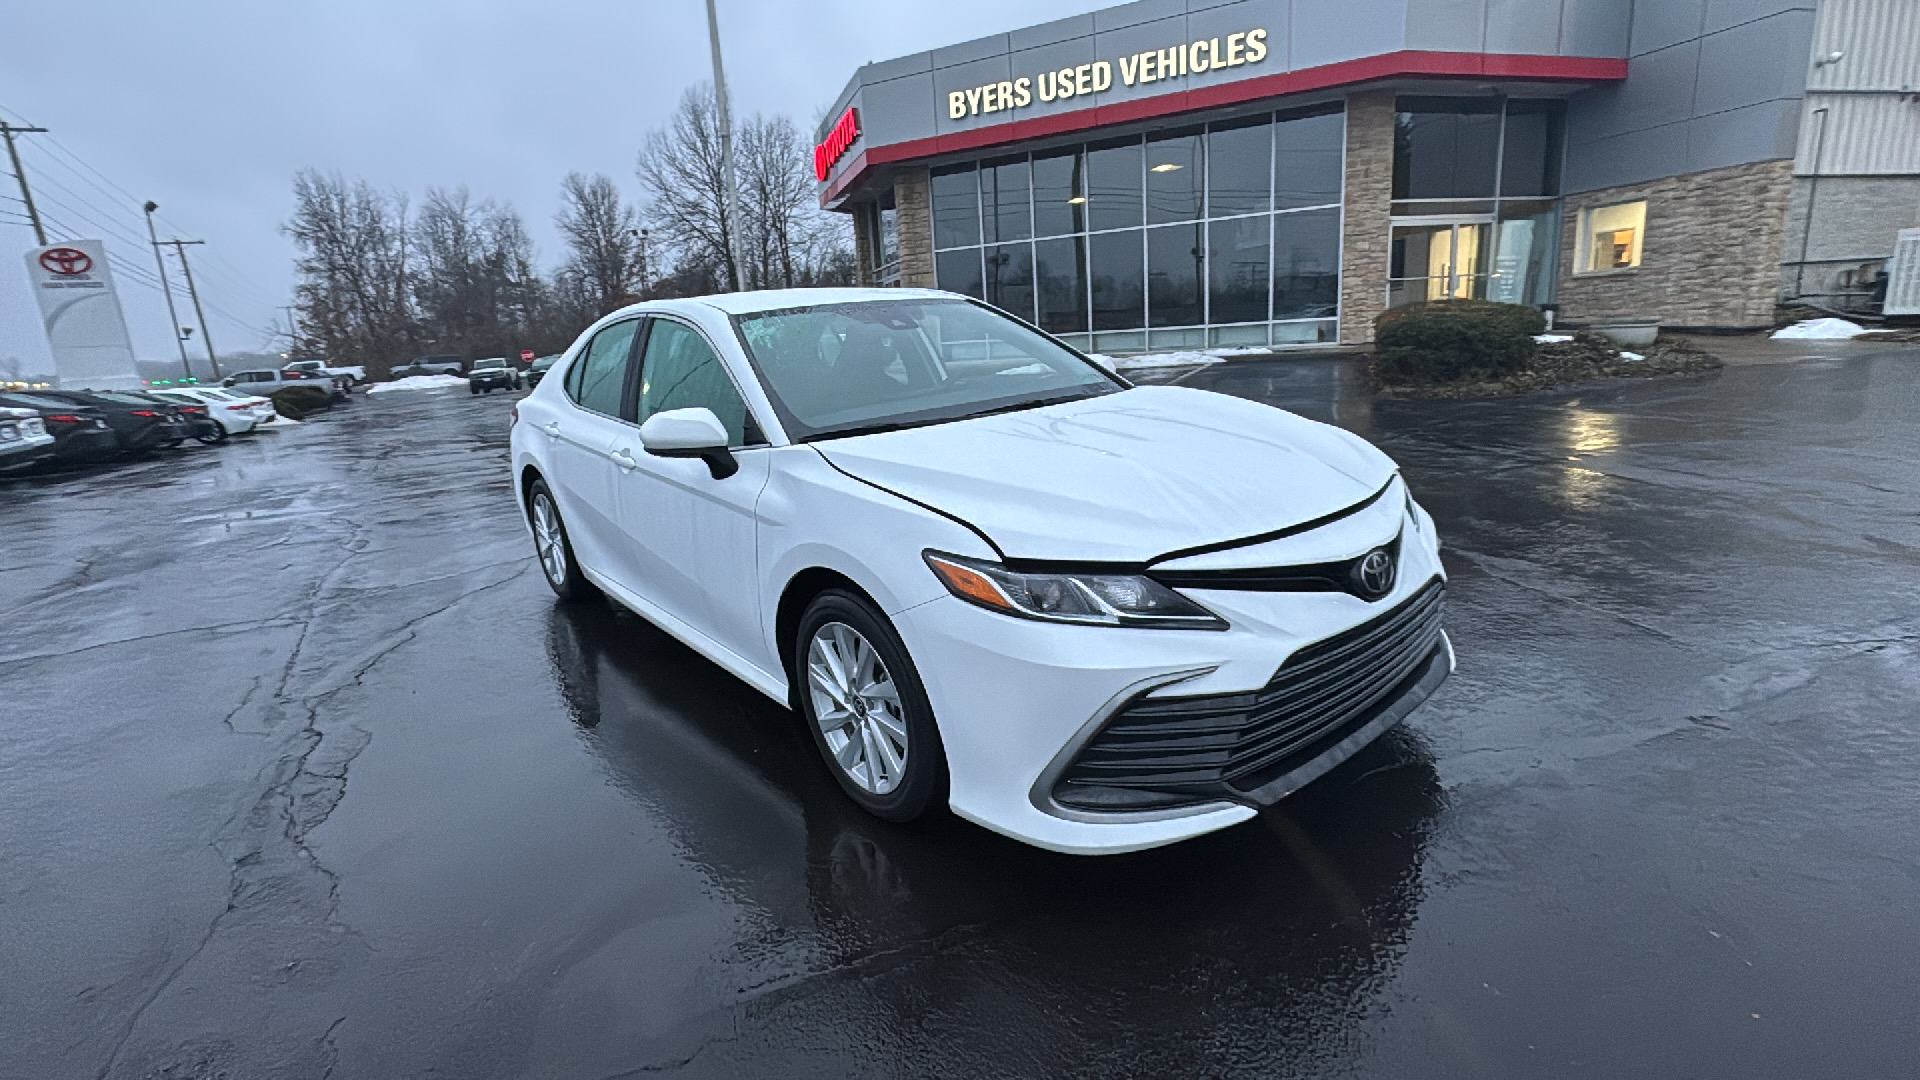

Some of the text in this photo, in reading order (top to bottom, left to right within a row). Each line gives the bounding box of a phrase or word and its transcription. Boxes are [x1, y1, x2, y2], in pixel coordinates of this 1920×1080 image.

[948, 28, 1267, 118] BYERS USED VEHICLES
[823, 106, 857, 168] TOYOTA
